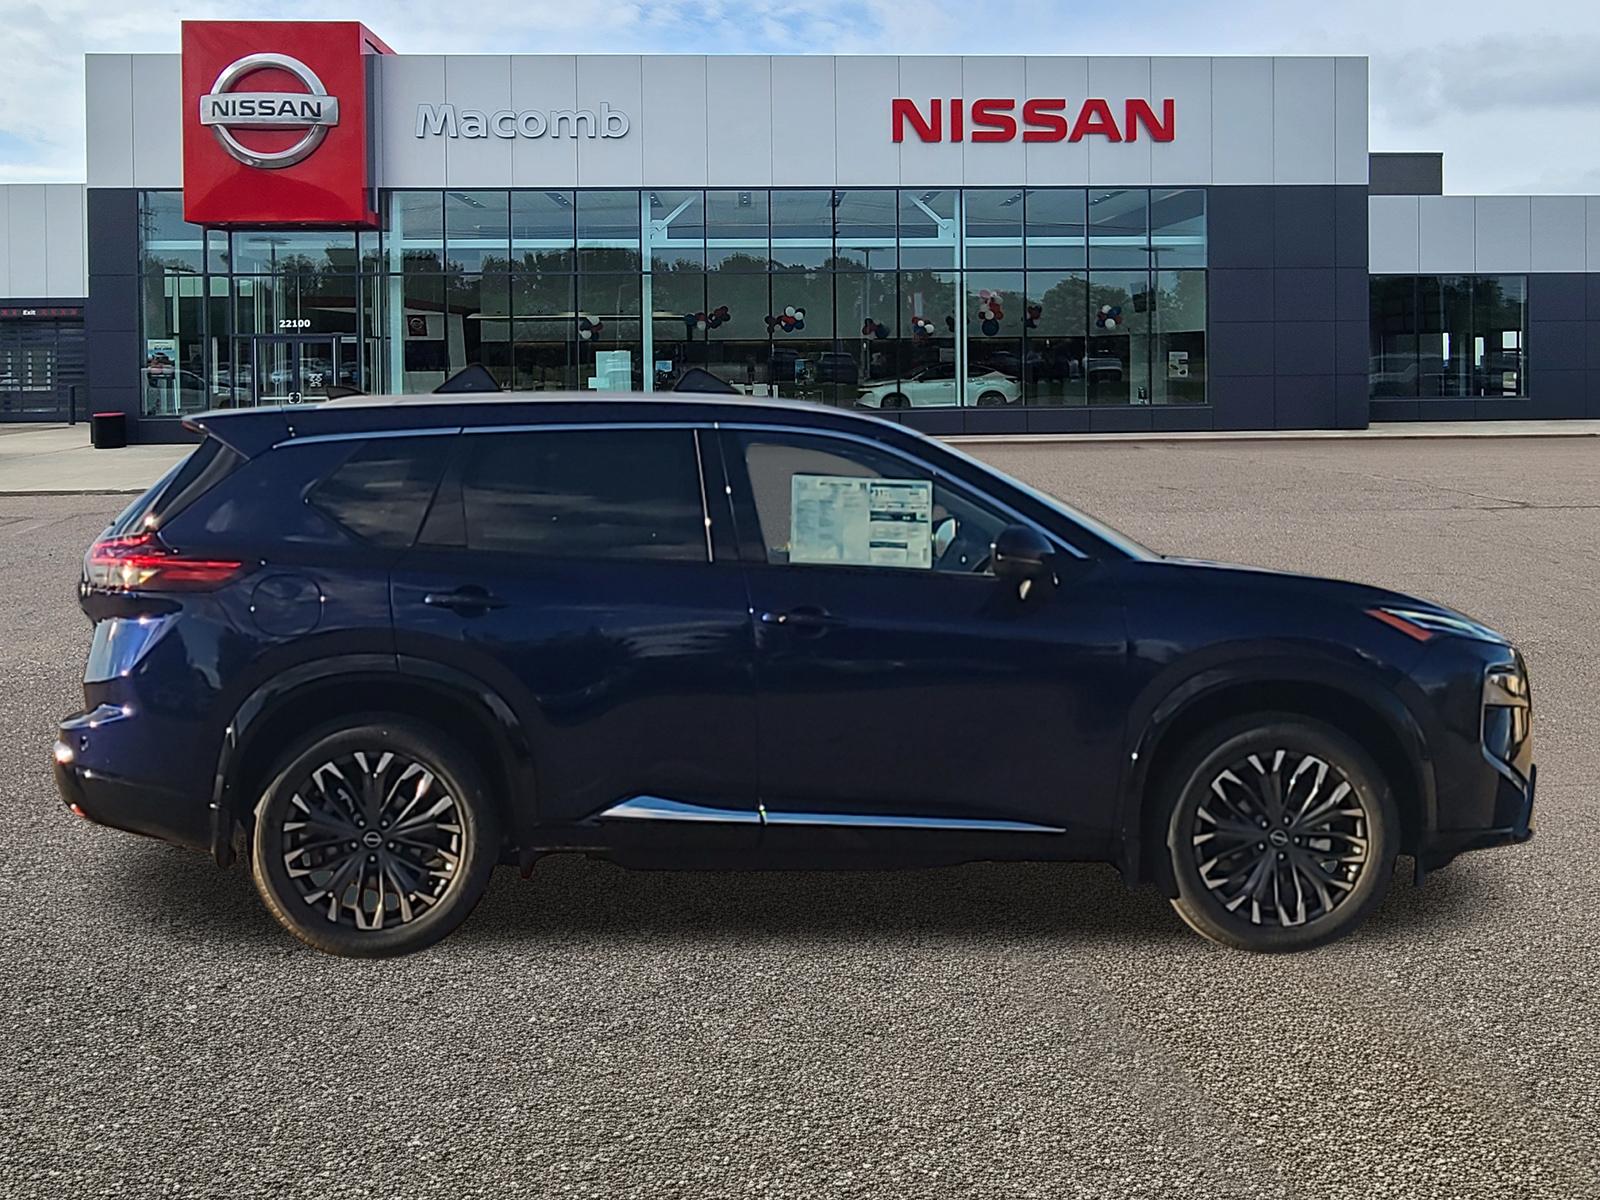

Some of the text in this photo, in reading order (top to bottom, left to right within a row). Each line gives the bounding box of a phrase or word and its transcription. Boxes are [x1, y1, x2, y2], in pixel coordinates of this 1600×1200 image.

[211, 100, 322, 118] NISSAN
[414, 101, 631, 139] Macomb
[892, 98, 1175, 143] NISSAN
[279, 319, 311, 328] 22100
